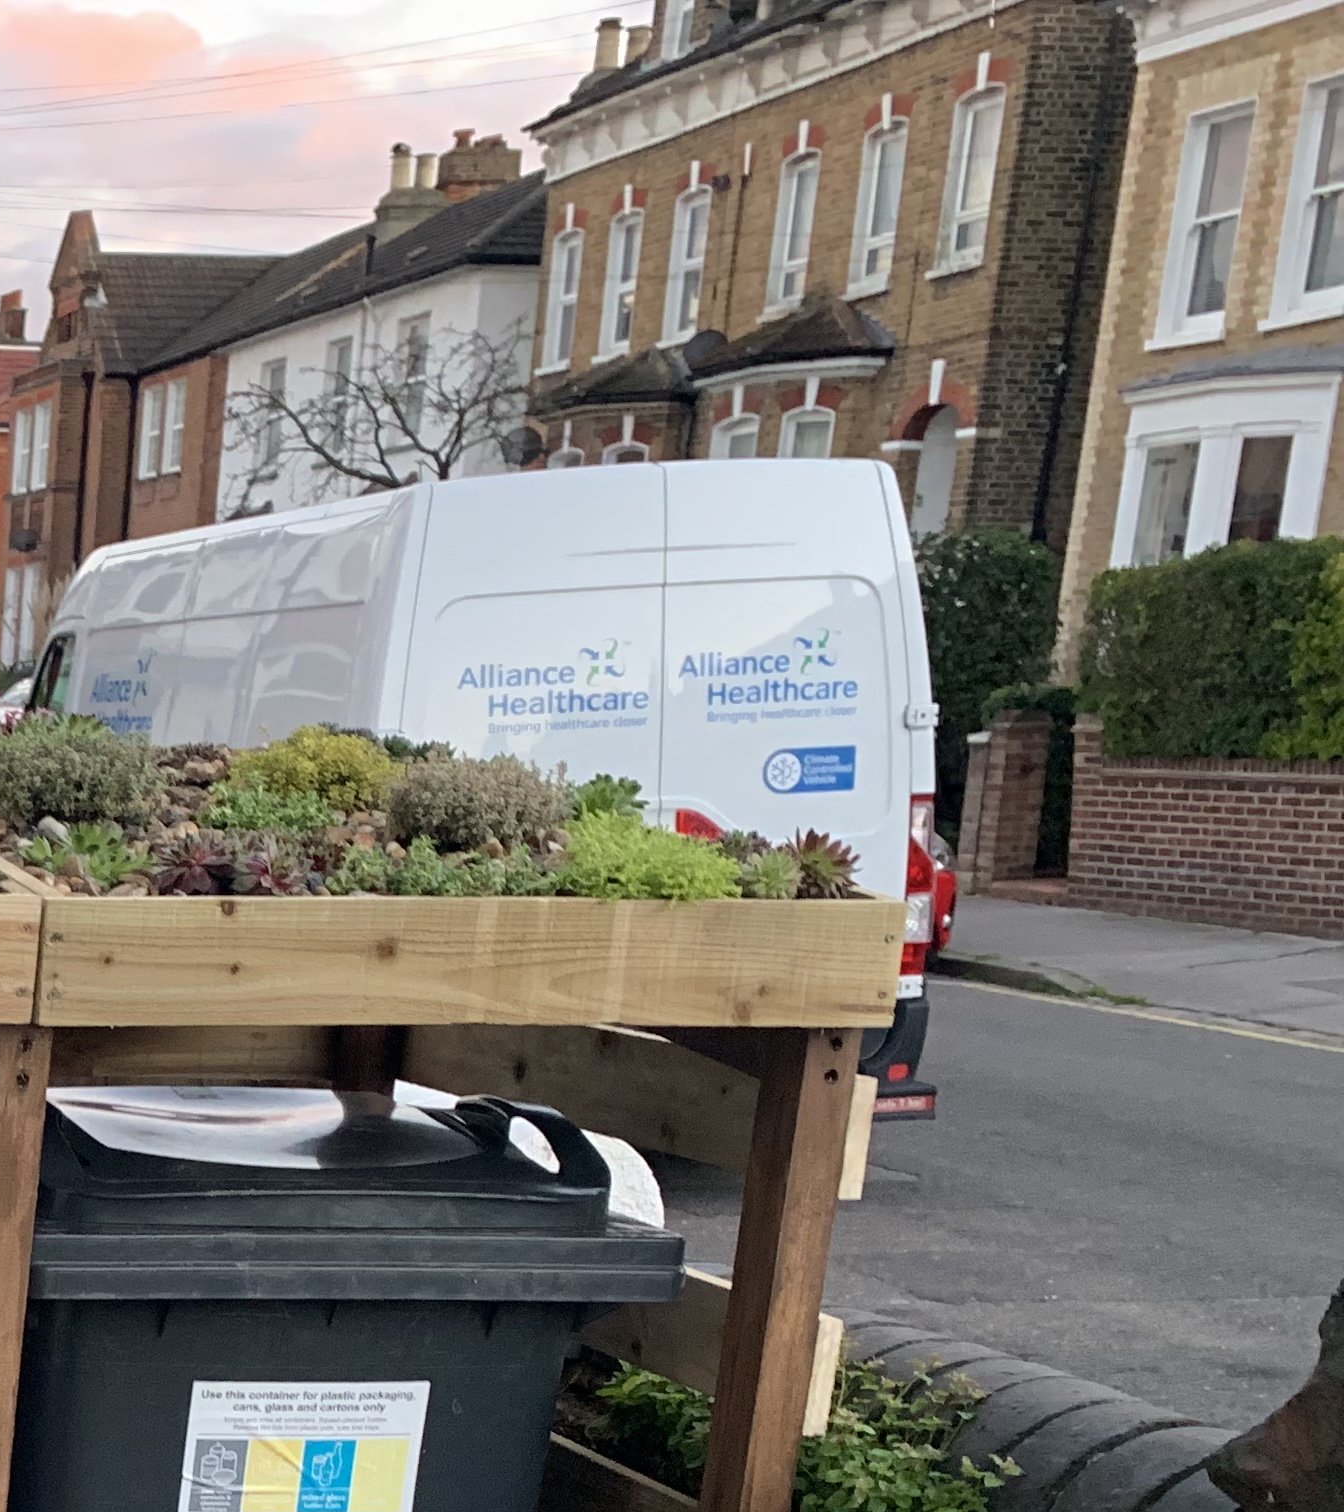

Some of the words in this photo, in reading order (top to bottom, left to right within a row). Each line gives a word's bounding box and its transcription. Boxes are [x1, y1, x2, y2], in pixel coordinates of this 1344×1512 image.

[458, 663, 576, 689] Alliance
[679, 652, 791, 678] Alliance
[92, 674, 131, 703] Alliance
[707, 678, 858, 706] Healthcare
[488, 689, 649, 717] Healthcare
[488, 722, 542, 735] Bringing
[545, 717, 610, 731] healthcare
[613, 716, 648, 727] closer
[706, 711, 757, 724] Bringing
[201, 1389, 223, 1400] Use
[225, 1390, 246, 1400] this
[248, 1391, 300, 1400] container
[302, 1390, 318, 1401] for
[320, 1391, 357, 1402] plastic
[232, 1403, 262, 1412] cans,
[264, 1402, 294, 1414] glass
[296, 1403, 318, 1412] and
[319, 1403, 360, 1412] cartons
[362, 1402, 386, 1413] only
